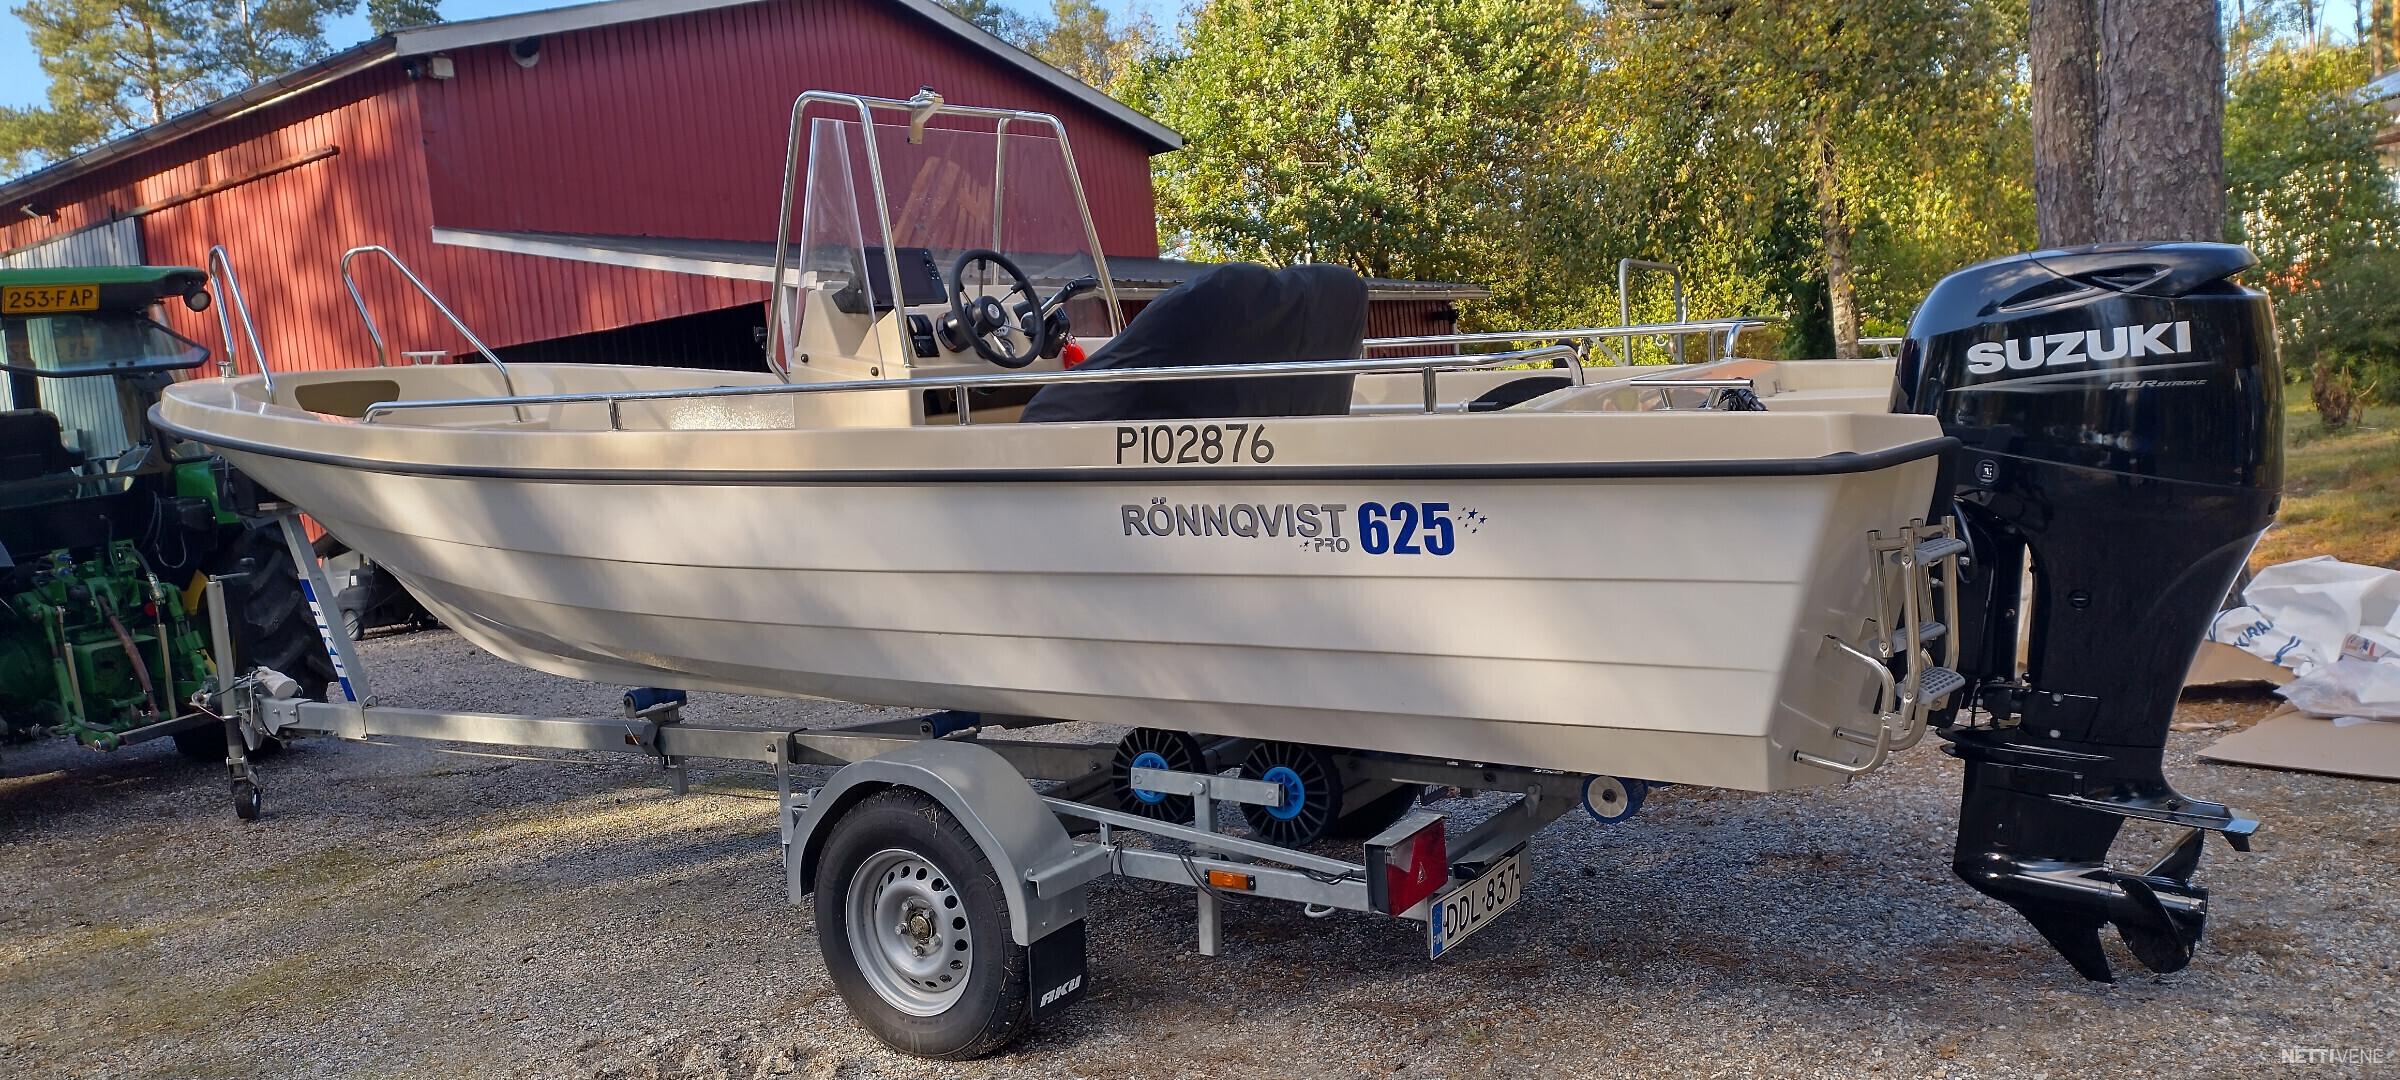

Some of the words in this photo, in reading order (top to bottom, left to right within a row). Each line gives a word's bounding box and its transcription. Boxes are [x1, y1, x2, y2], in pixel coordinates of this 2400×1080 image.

[9, 288, 94, 309] 253-FAP
[1967, 320, 2192, 375] SUZUKI
[1116, 423, 1275, 465] P102876
[1120, 496, 1347, 539] RÖNNQVIST
[1357, 501, 1456, 556] 625
[1314, 537, 1351, 553] PRO
[309, 601, 348, 678] AKU
[1446, 862, 1516, 940] DDL-837
[1039, 974, 1082, 1008] AKU
